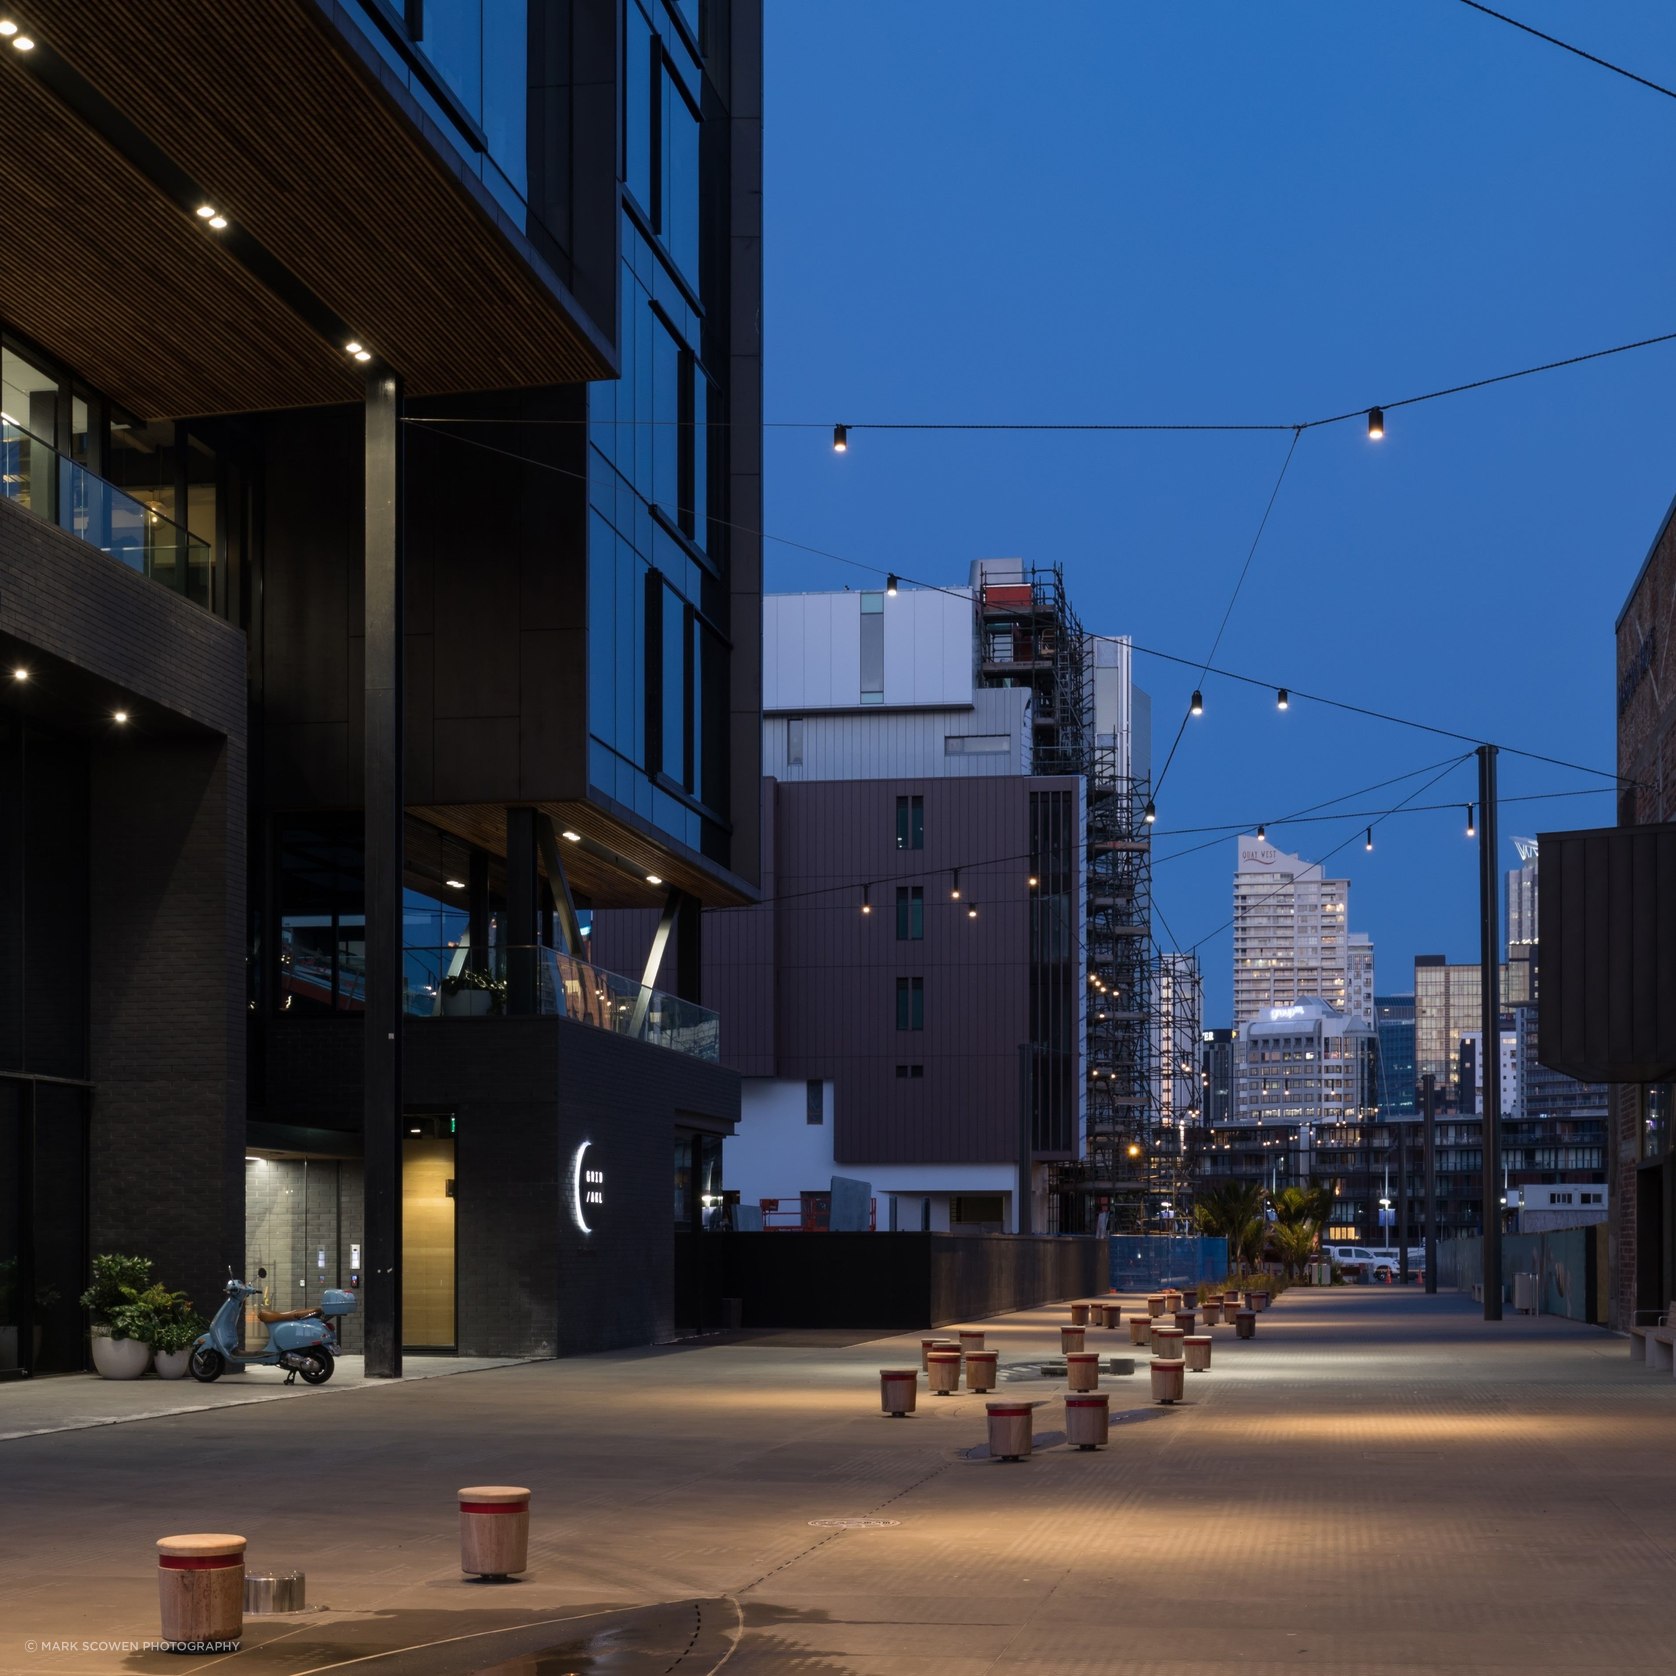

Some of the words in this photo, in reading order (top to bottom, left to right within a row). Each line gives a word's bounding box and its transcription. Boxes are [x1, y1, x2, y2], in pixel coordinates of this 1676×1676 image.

[1243, 851, 1257, 859] QUAY
[1261, 851, 1276, 859] WEST
[586, 1170, 603, 1183] GRID
